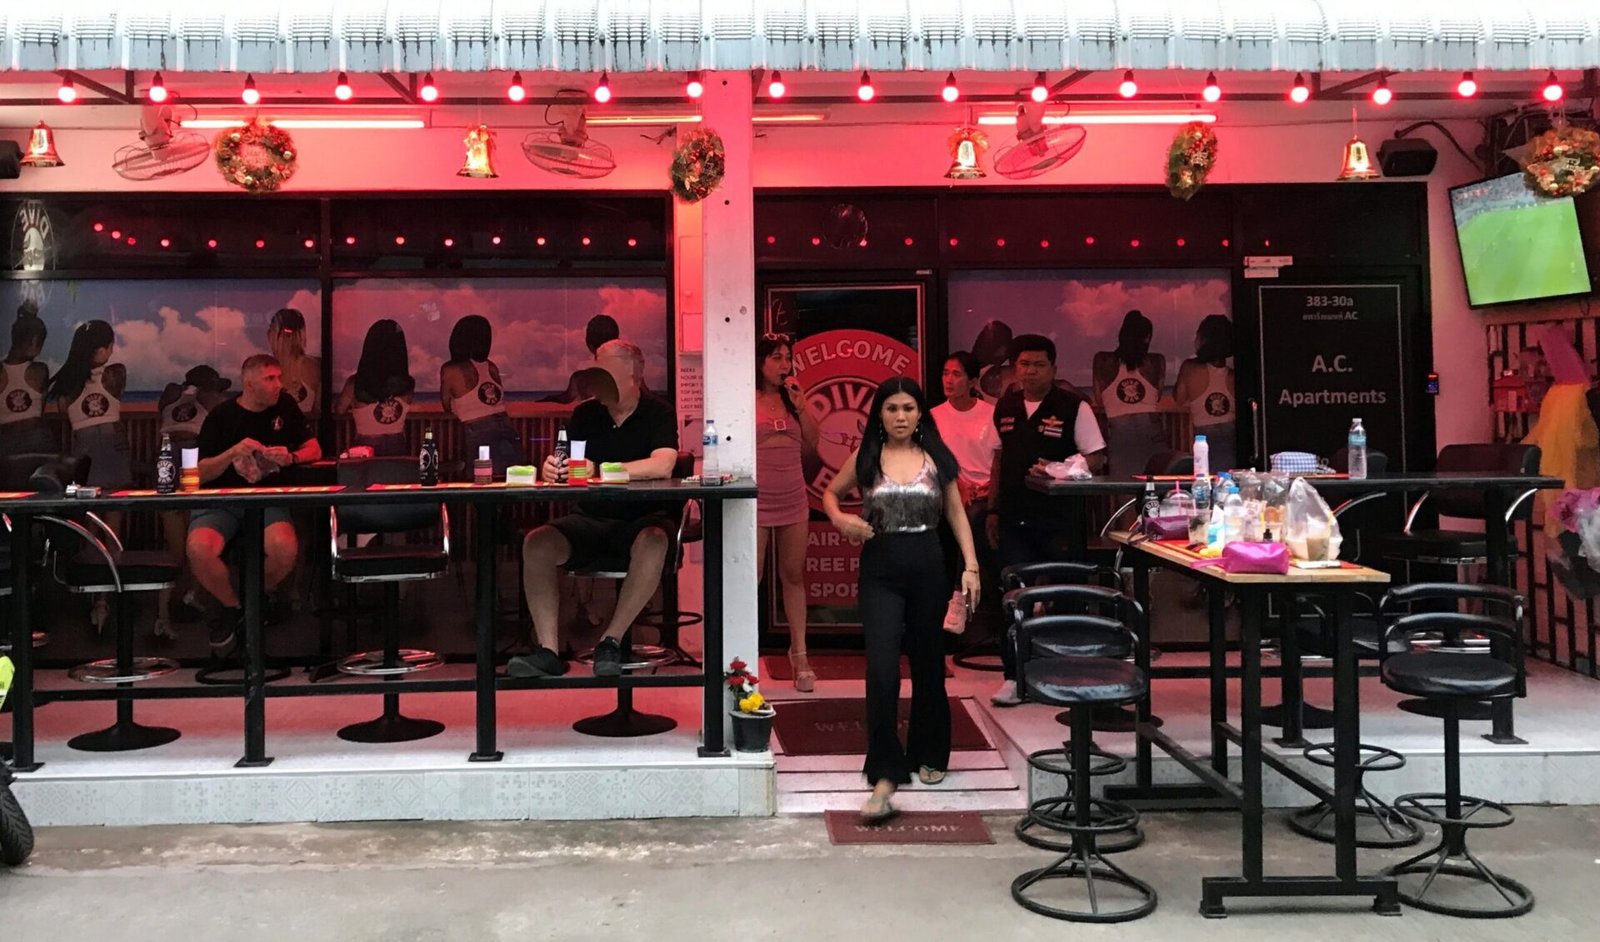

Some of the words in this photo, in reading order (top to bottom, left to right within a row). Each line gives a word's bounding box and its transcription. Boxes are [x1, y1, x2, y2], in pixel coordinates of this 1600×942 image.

[1306, 295, 1354, 307] 383-30a
[1344, 311, 1358, 320] AC
[793, 340, 910, 376] WELCOME
[1312, 355, 1353, 373] A.C.
[1278, 389, 1387, 408] Apartments
[807, 532, 863, 547] AIR-C
[806, 557, 845, 572] REE
